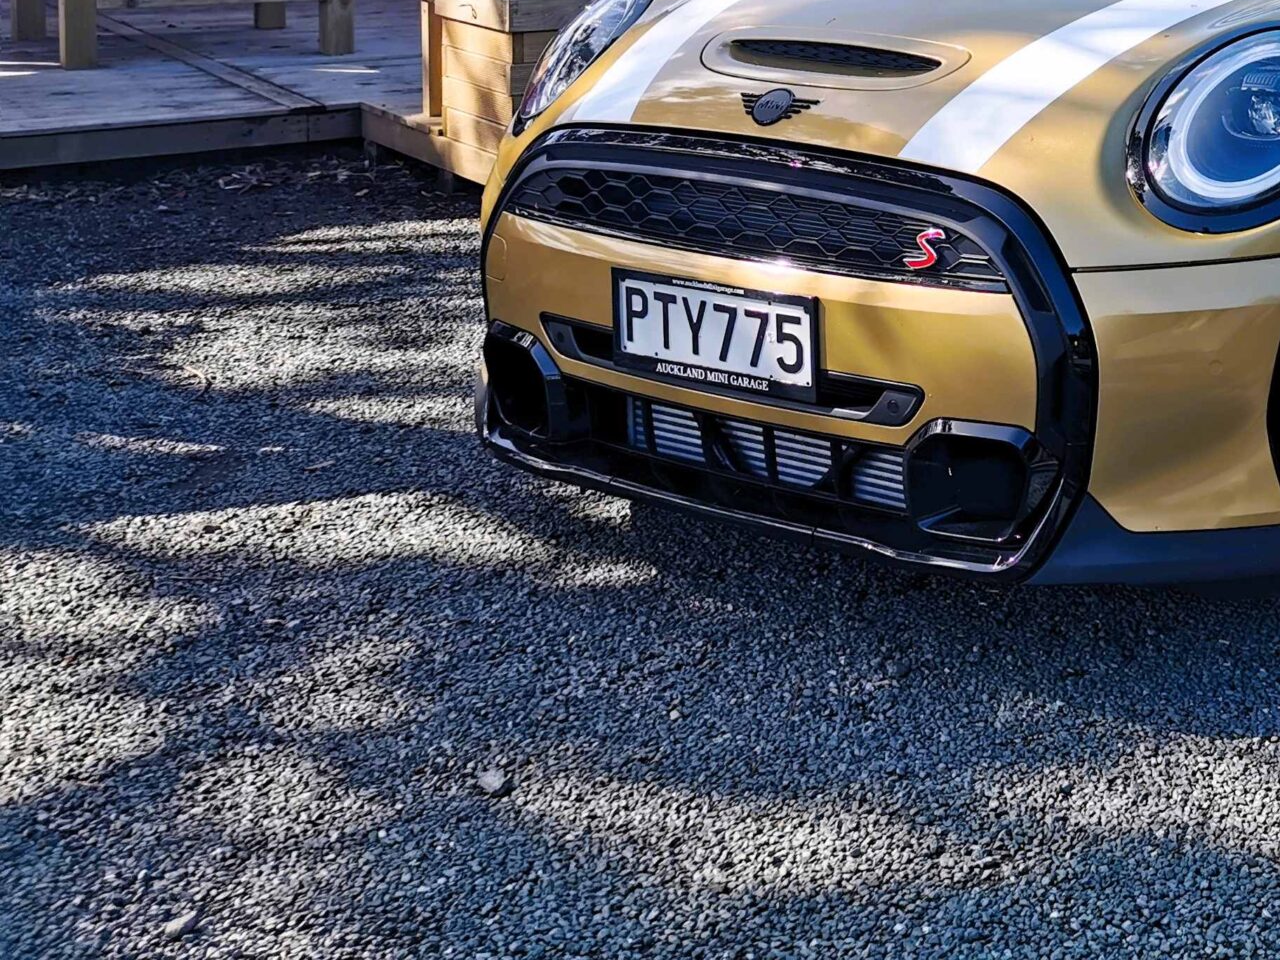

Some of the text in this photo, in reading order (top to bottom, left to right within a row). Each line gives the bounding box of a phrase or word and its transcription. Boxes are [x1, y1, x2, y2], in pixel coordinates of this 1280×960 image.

[757, 98, 786, 111] MINI
[902, 227, 947, 270] S
[625, 285, 805, 375] PTY775
[656, 362, 769, 391] AUCKLAND MINI GARAGE
